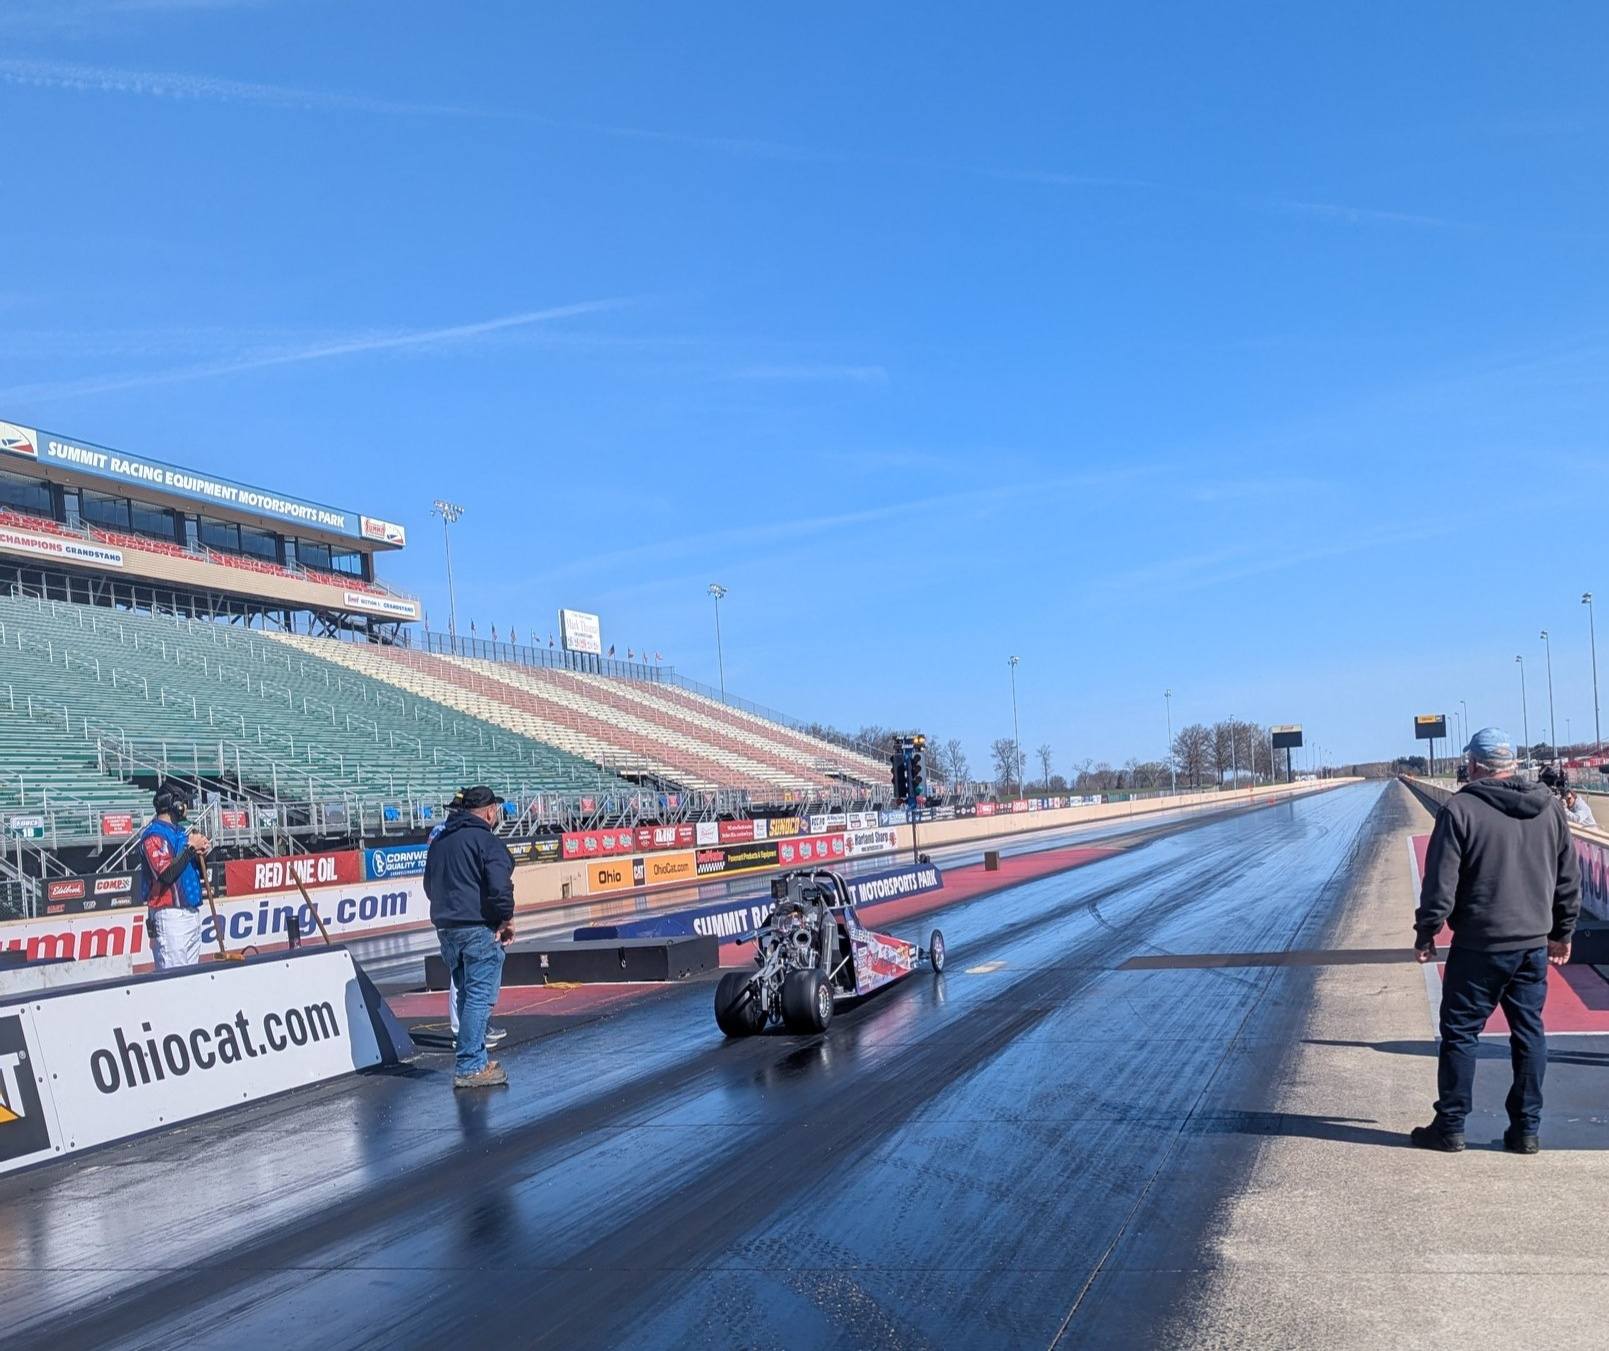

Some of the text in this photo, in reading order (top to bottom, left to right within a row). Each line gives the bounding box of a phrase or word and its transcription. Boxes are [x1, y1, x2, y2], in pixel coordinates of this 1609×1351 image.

[48, 441, 345, 528] SUMMIT RACING EQUIPMENT MOTORSPORTS PARK
[0, 534, 121, 562] CHAMPIONS GRANDSTAND
[769, 817, 800, 836] SUNOCO
[254, 861, 282, 889] RED
[317, 857, 338, 883] OIL
[386, 861, 416, 871] QUALITY
[598, 870, 621, 885] Ohio
[633, 864, 644, 880] CAT
[653, 861, 689, 876] OhioCat.com
[859, 873, 917, 901] MOTORSPORTS
[918, 869, 938, 888] PARK
[693, 908, 748, 938] SUMMIT
[90, 1001, 340, 1095] ohiocat.com
